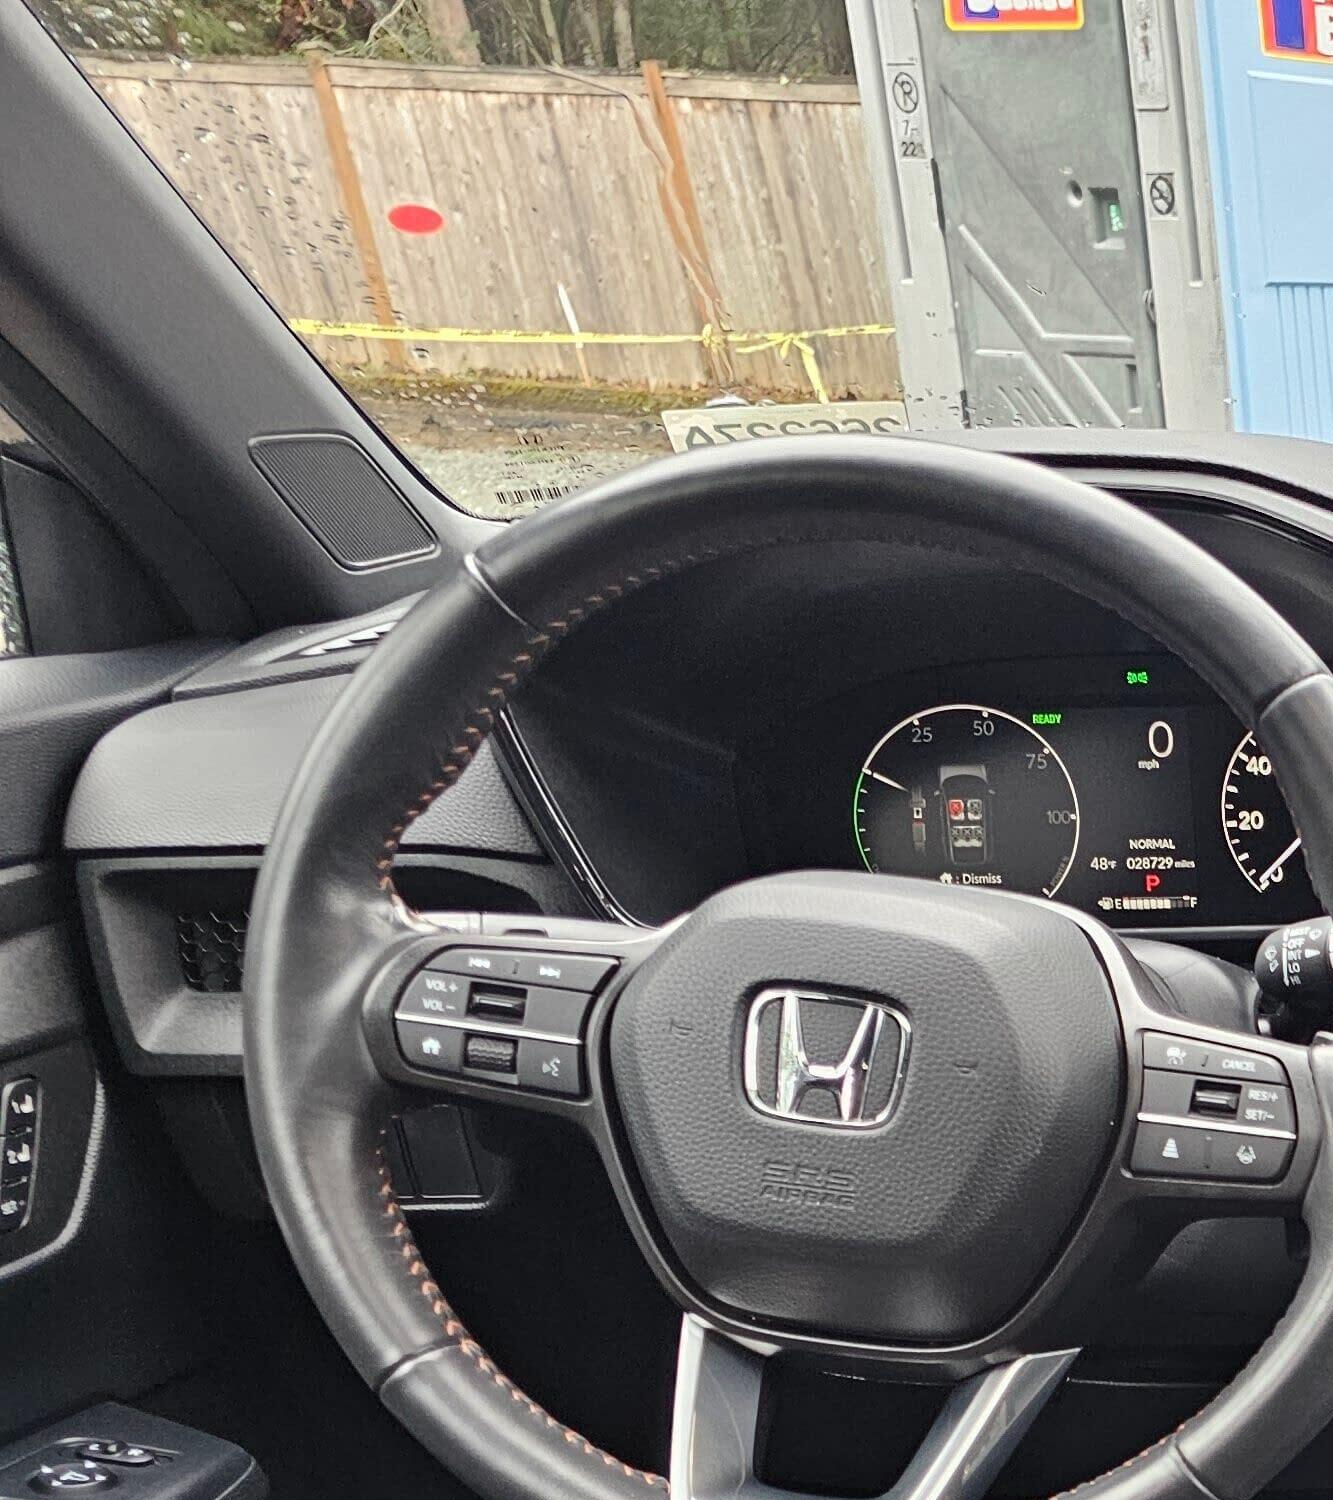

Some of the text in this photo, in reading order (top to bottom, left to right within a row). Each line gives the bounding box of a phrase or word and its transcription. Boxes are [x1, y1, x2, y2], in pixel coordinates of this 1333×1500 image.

[1032, 714, 1062, 724] READY
[973, 720, 995, 736] 50
[912, 728, 933, 742] 25
[1148, 720, 1174, 758] 0
[1026, 754, 1047, 769] 75
[1138, 759, 1159, 770] mph
[1246, 755, 1272, 775] 40
[1046, 810, 1070, 824] 100
[1238, 811, 1264, 831] 20
[1129, 839, 1175, 849] NORMAL
[1126, 856, 1173, 869] 028729
[962, 874, 1001, 884] Dismiss
[1146, 874, 1160, 891] P
[1115, 899, 1122, 909] E
[1190, 897, 1198, 908] F
[1287, 938, 1305, 949] OFF
[1288, 962, 1300, 973] LO
[426, 979, 447, 992] VOL
[422, 999, 444, 1012] VOL
